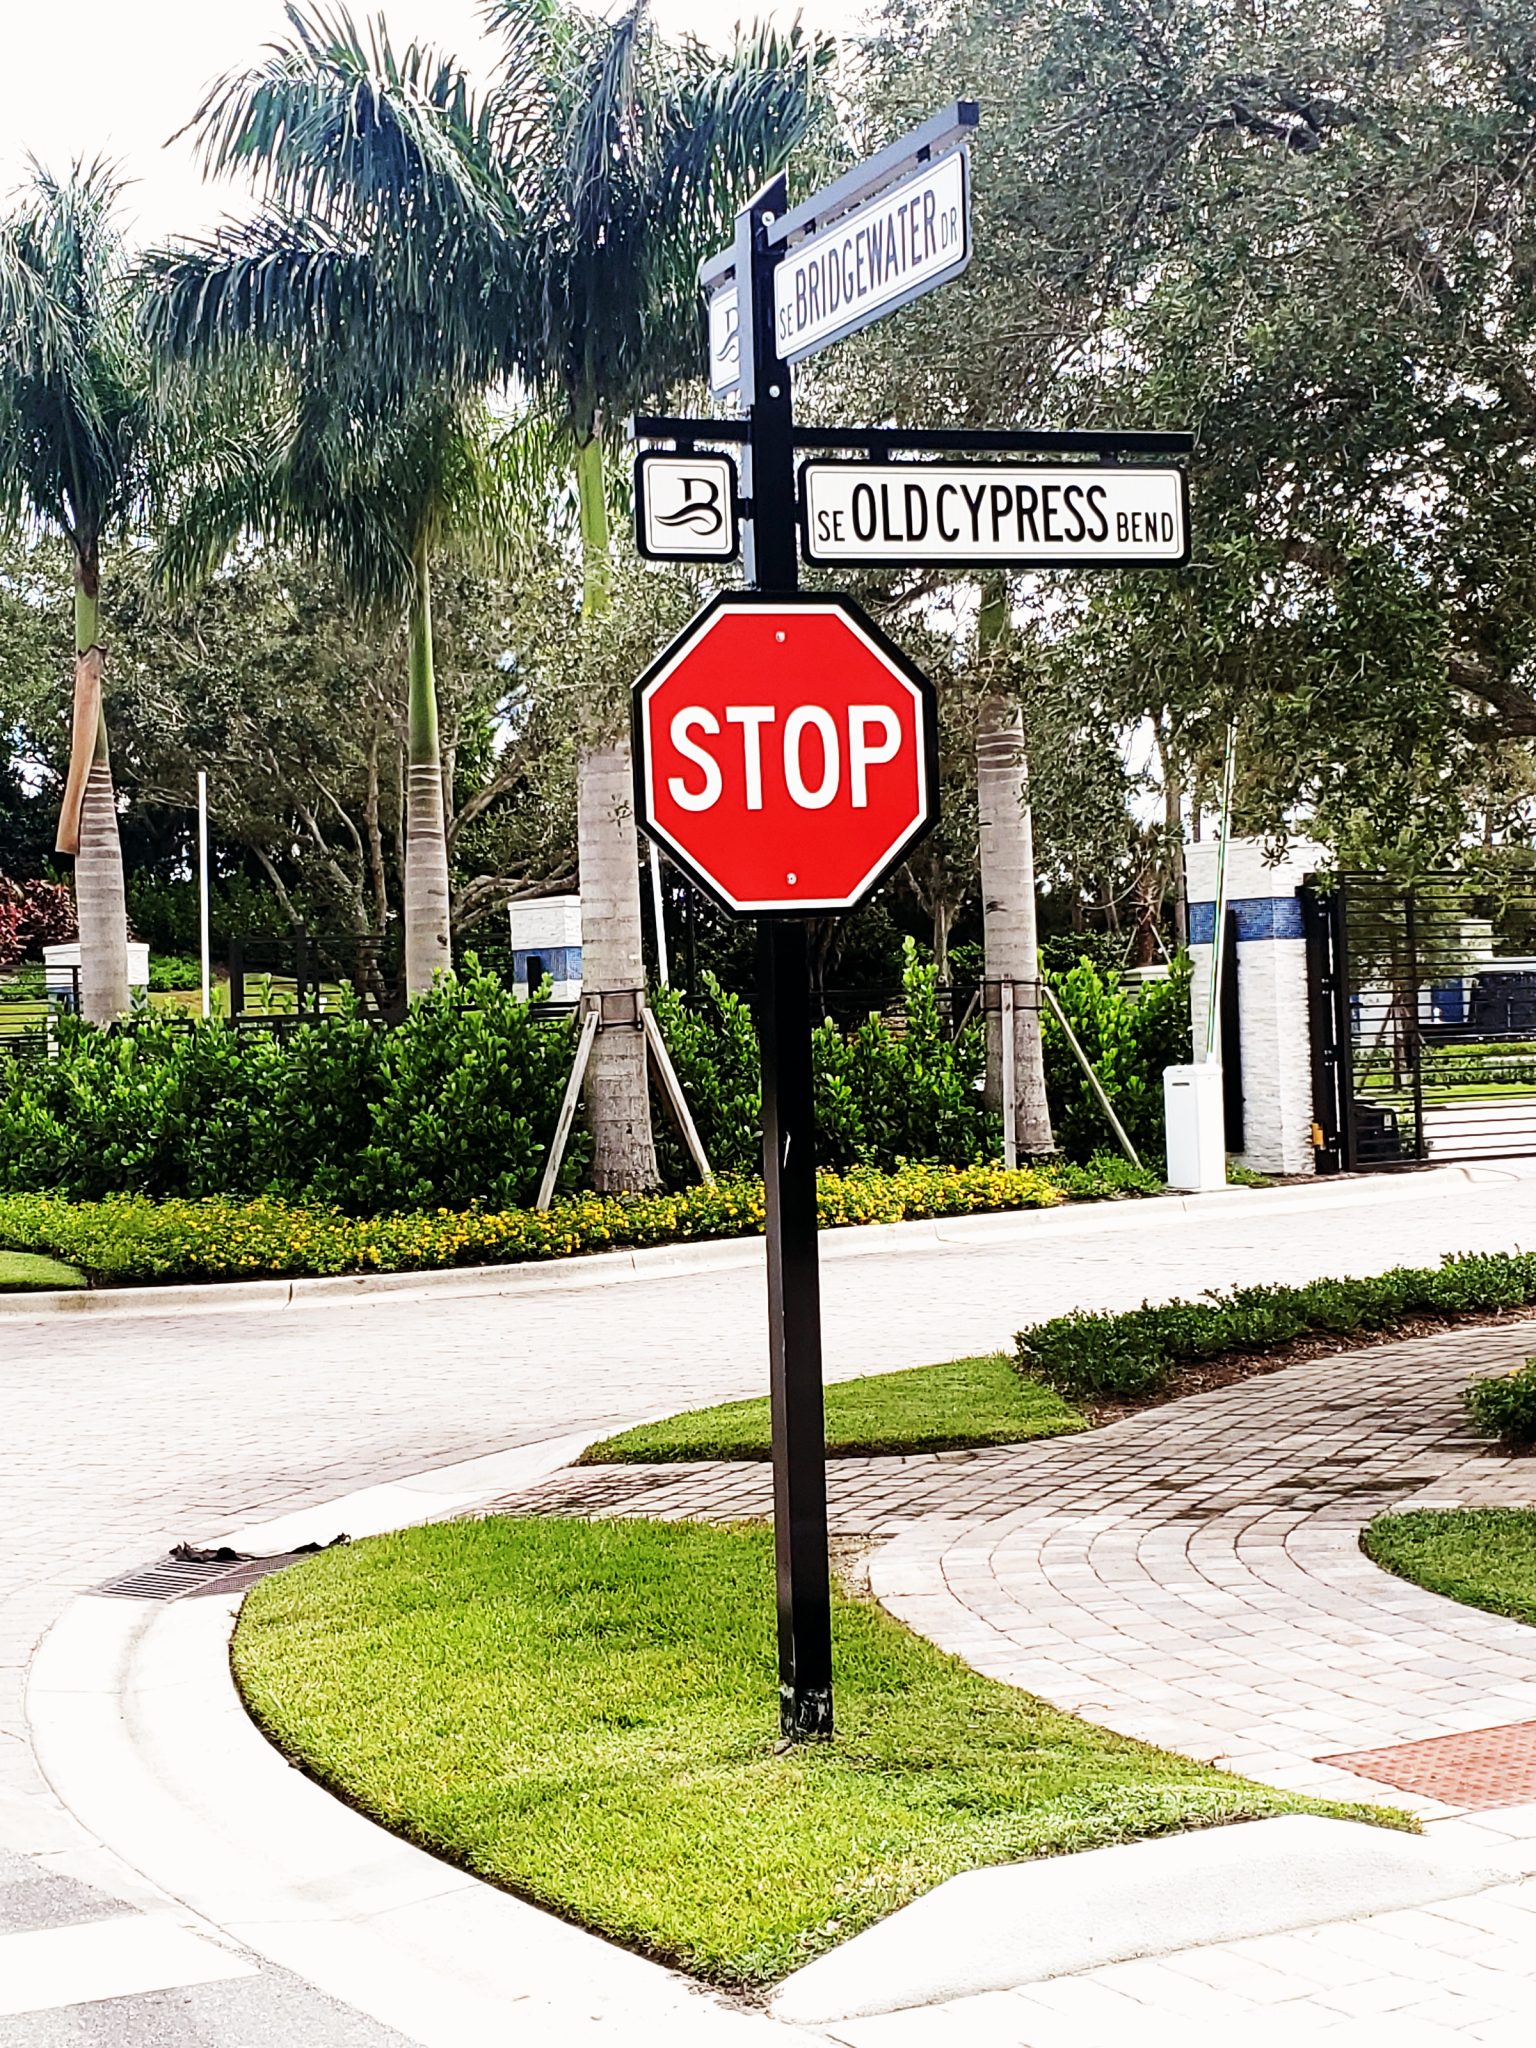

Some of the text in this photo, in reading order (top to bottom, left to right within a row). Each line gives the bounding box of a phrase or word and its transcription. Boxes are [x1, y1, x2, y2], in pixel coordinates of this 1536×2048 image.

[780, 303, 793, 341] SE
[795, 189, 937, 332] BRIDGEWATER
[941, 207, 958, 250] DR
[817, 483, 1174, 543] SE OLD CYPRESS BEND
[667, 704, 902, 812] STOP
